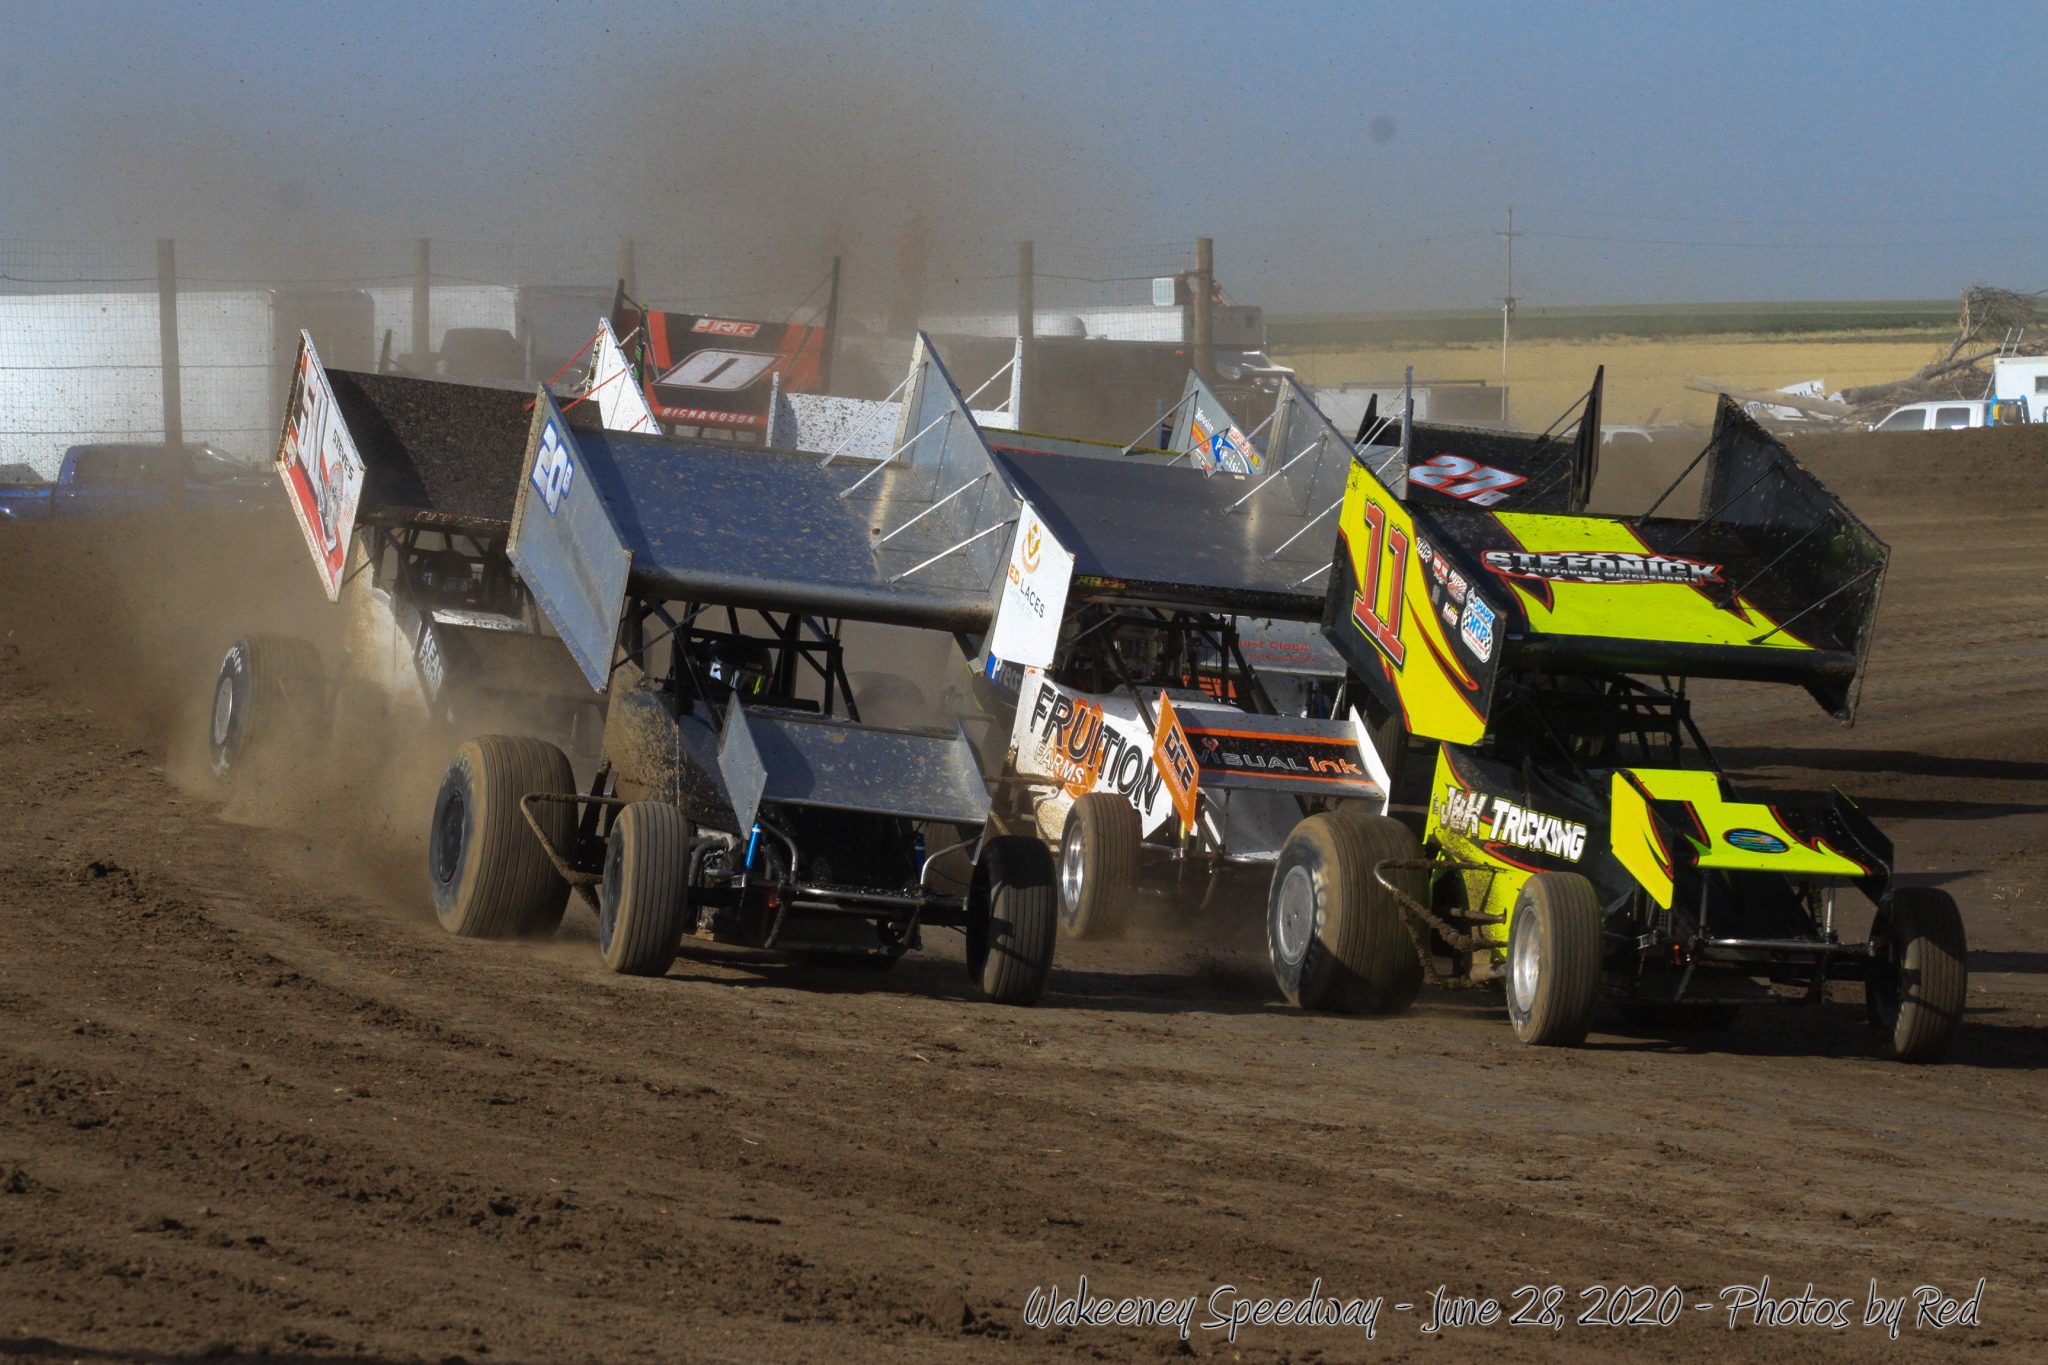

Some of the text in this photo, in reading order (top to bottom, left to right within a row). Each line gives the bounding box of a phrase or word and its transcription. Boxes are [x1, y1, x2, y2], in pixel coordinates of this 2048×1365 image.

[1352, 498, 1406, 671] 11
[1485, 551, 1720, 580] STEFONICK
[1020, 578, 1045, 618] LACES
[1030, 682, 1162, 816] FRUITION
[1034, 741, 1085, 785] FARMS
